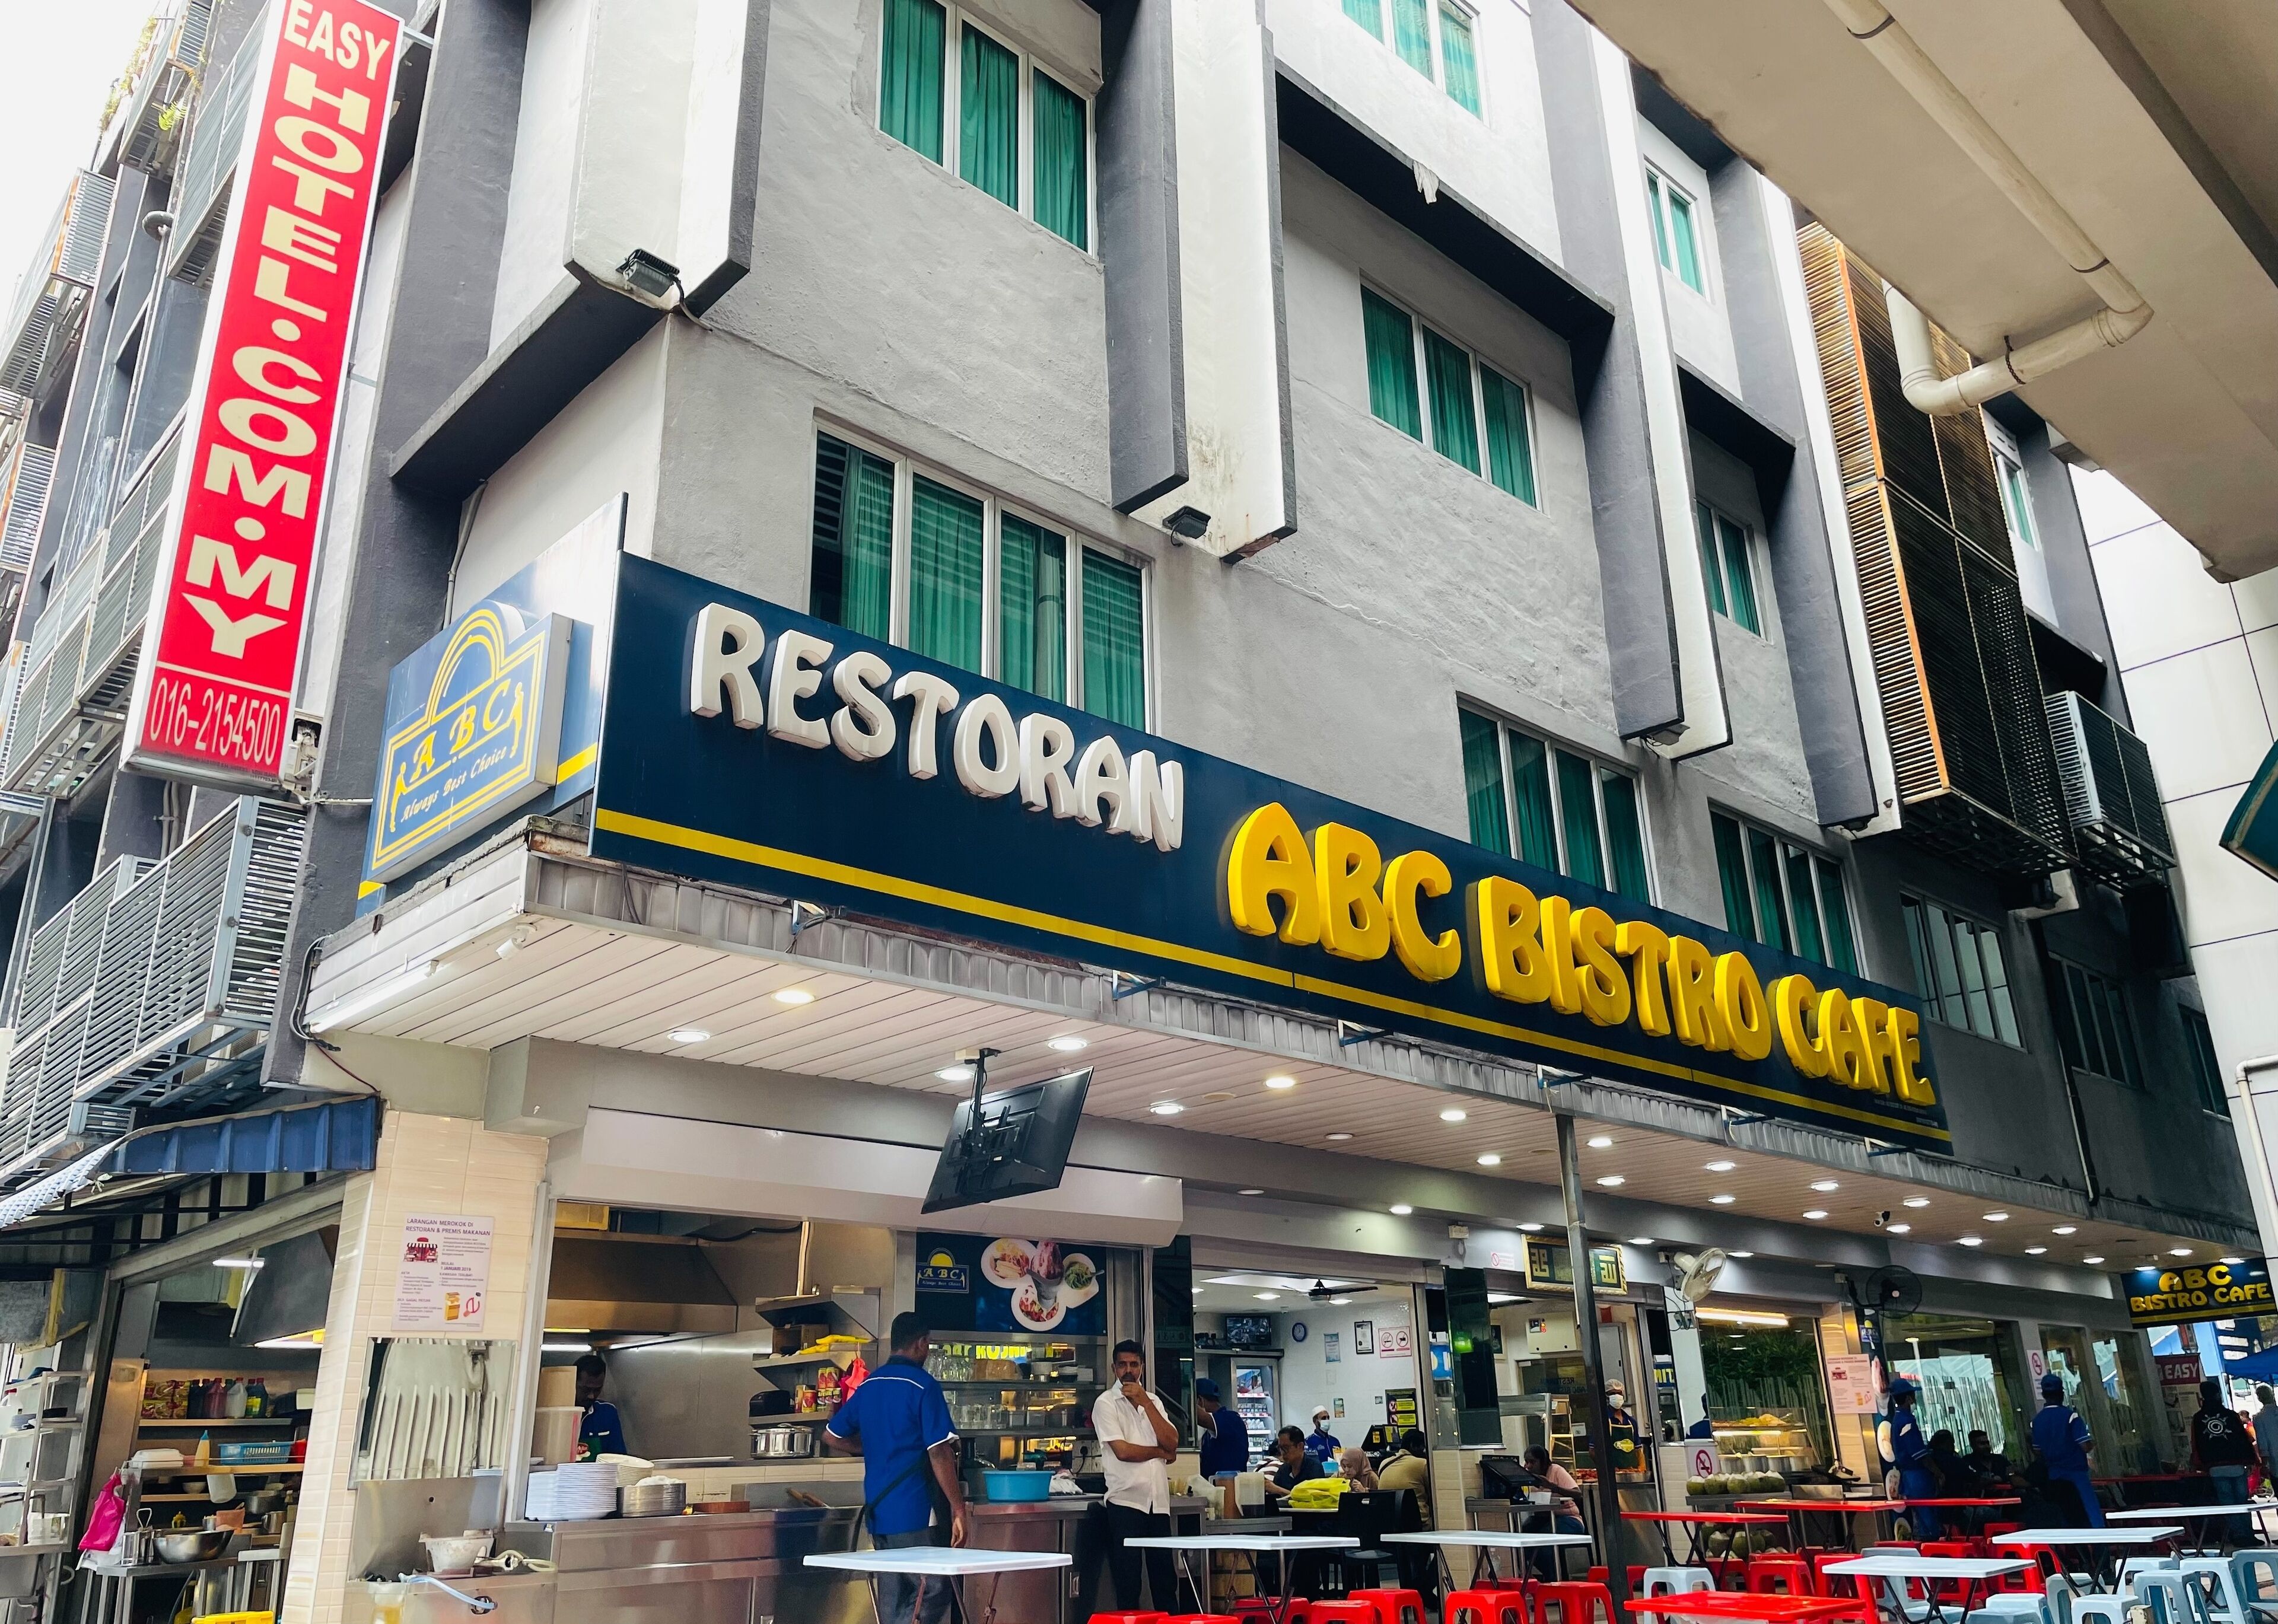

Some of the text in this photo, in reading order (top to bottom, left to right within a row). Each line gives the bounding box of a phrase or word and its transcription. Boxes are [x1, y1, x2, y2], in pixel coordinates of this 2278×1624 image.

[284, 1, 390, 81] EASY
[150, 677, 281, 765] 016-2154500
[690, 601, 1184, 852] RESTORAN
[400, 746, 508, 823] Always Best Choice
[1227, 802, 1936, 1107] ABC BISTRO CAFE
[2130, 1282, 2271, 1312] BISTRO CAFE
[2158, 1265, 2232, 1292] ABC
[2164, 1363, 2199, 1379] EASY
